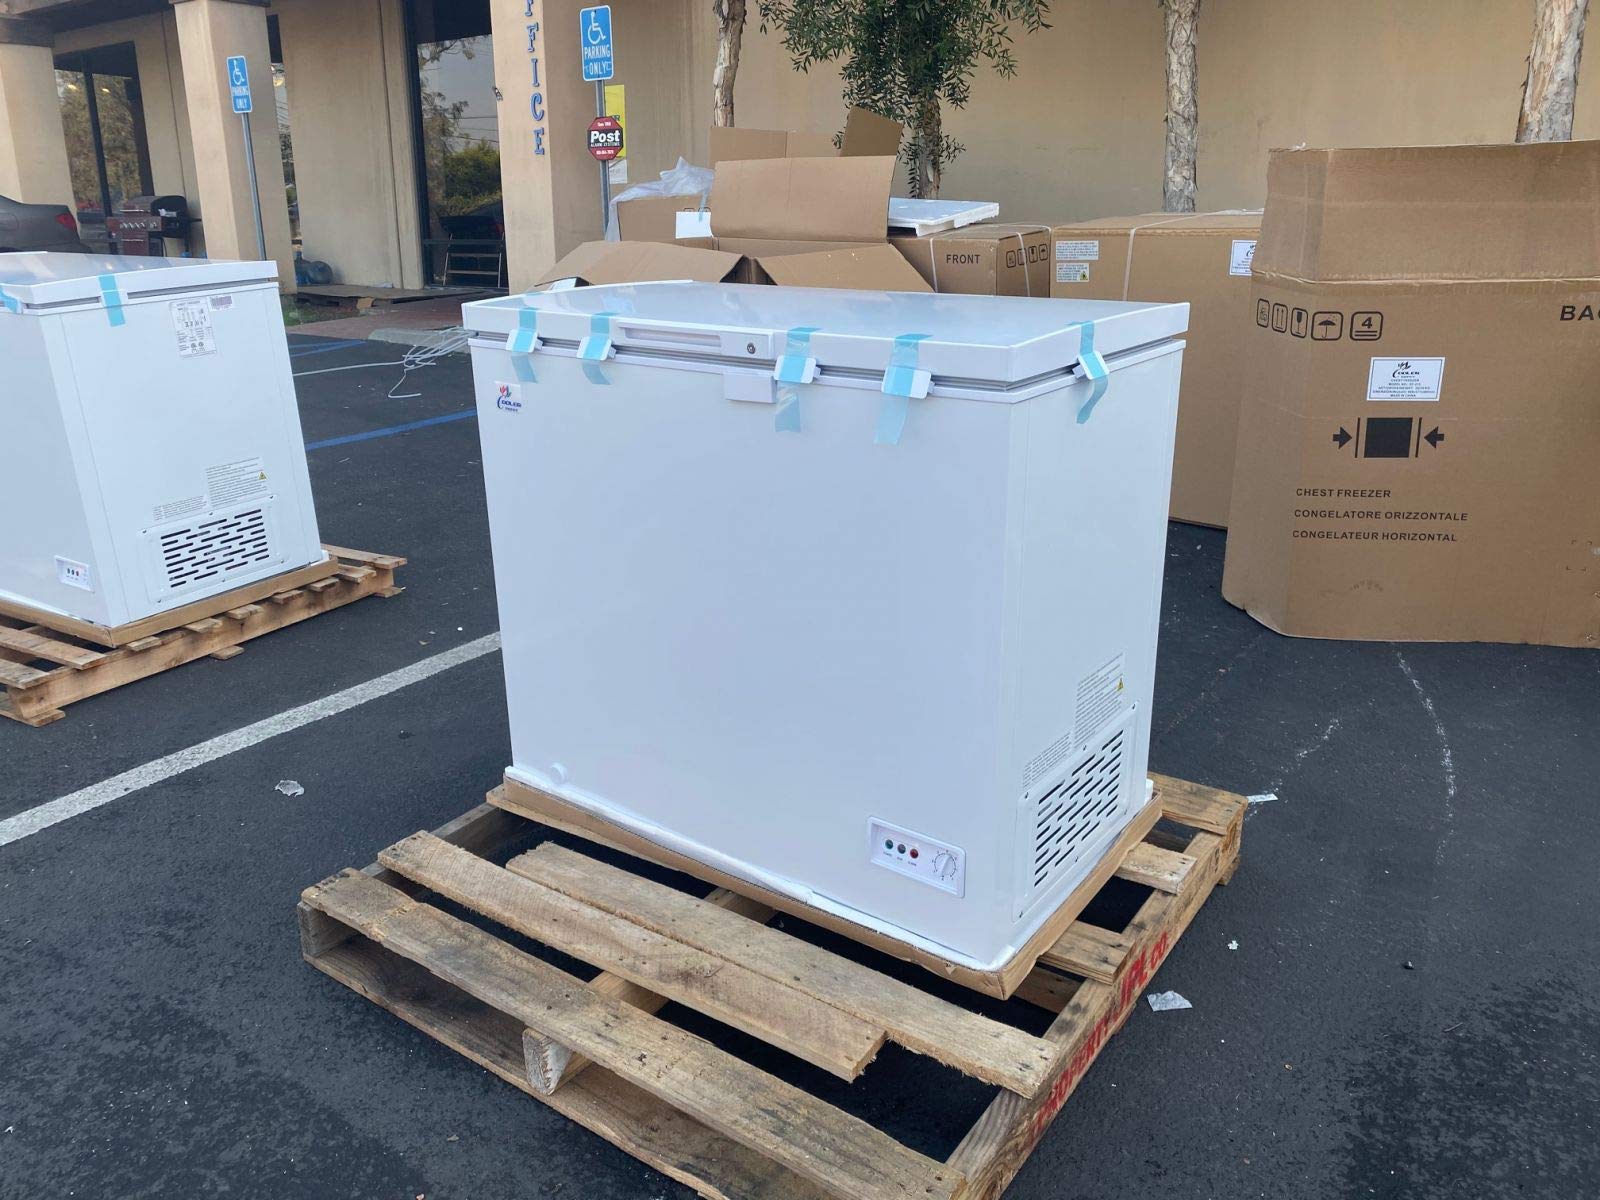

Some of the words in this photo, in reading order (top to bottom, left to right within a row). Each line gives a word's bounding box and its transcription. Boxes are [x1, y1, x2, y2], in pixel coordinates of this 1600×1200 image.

[583, 44, 611, 60] PARKING
[589, 61, 607, 75] ONLY
[590, 130, 620, 143] Post
[946, 254, 981, 264] FRONT
[1560, 305, 1600, 321] BA
[1361, 317, 1373, 329] 4
[1296, 488, 1334, 498] CHEST
[1337, 489, 1391, 499] FREEZER
[1294, 509, 1381, 520] CONGELATORE
[1384, 511, 1468, 522] ORIZZONTALE
[1292, 530, 1379, 541] CONGELATEUR
[1382, 532, 1457, 542] HORIZONTAL
